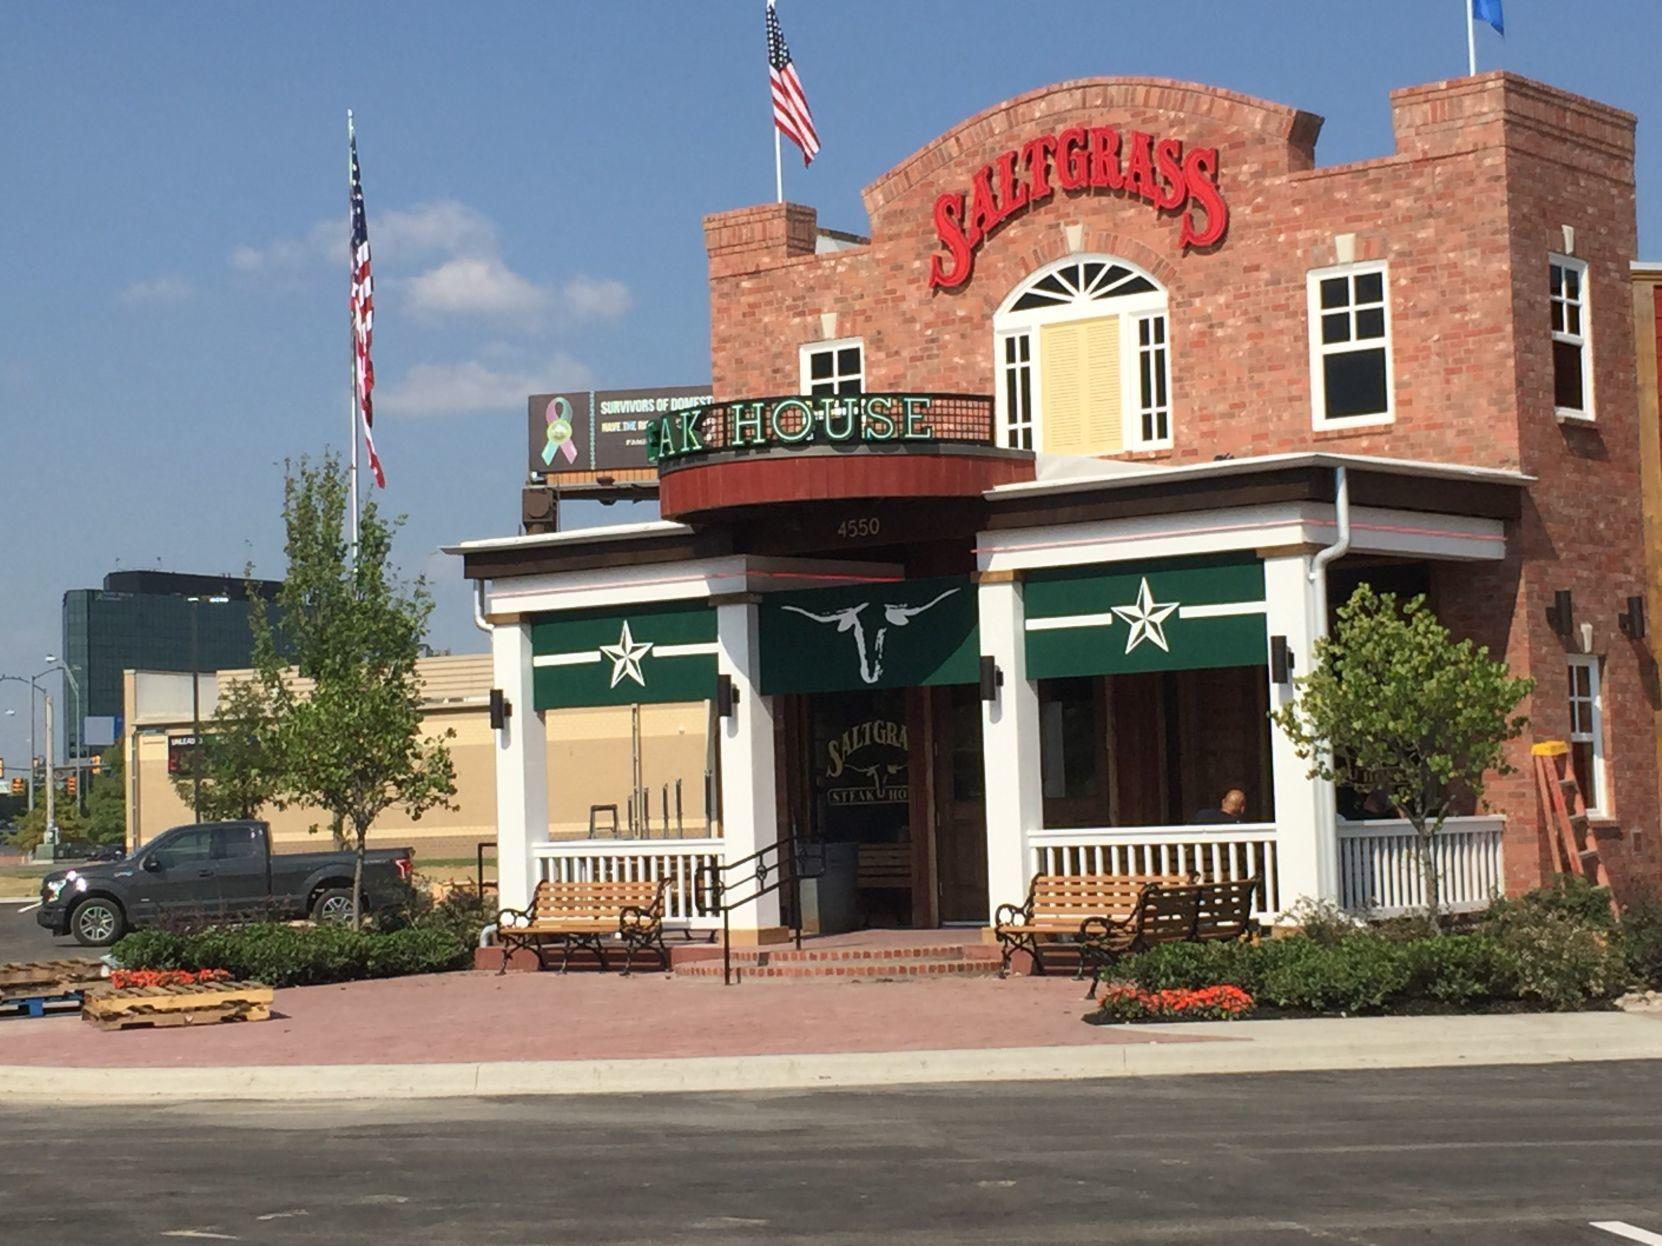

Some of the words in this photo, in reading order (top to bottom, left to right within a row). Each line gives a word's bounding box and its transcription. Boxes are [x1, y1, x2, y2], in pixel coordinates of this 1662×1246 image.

[929, 126, 1229, 288] SALTGRASS
[600, 399, 655, 415] SURVIVORS
[656, 398, 669, 412] OF
[731, 397, 932, 447] HOUSE
[837, 517, 880, 538] 4550
[832, 789, 875, 802] STEAK
